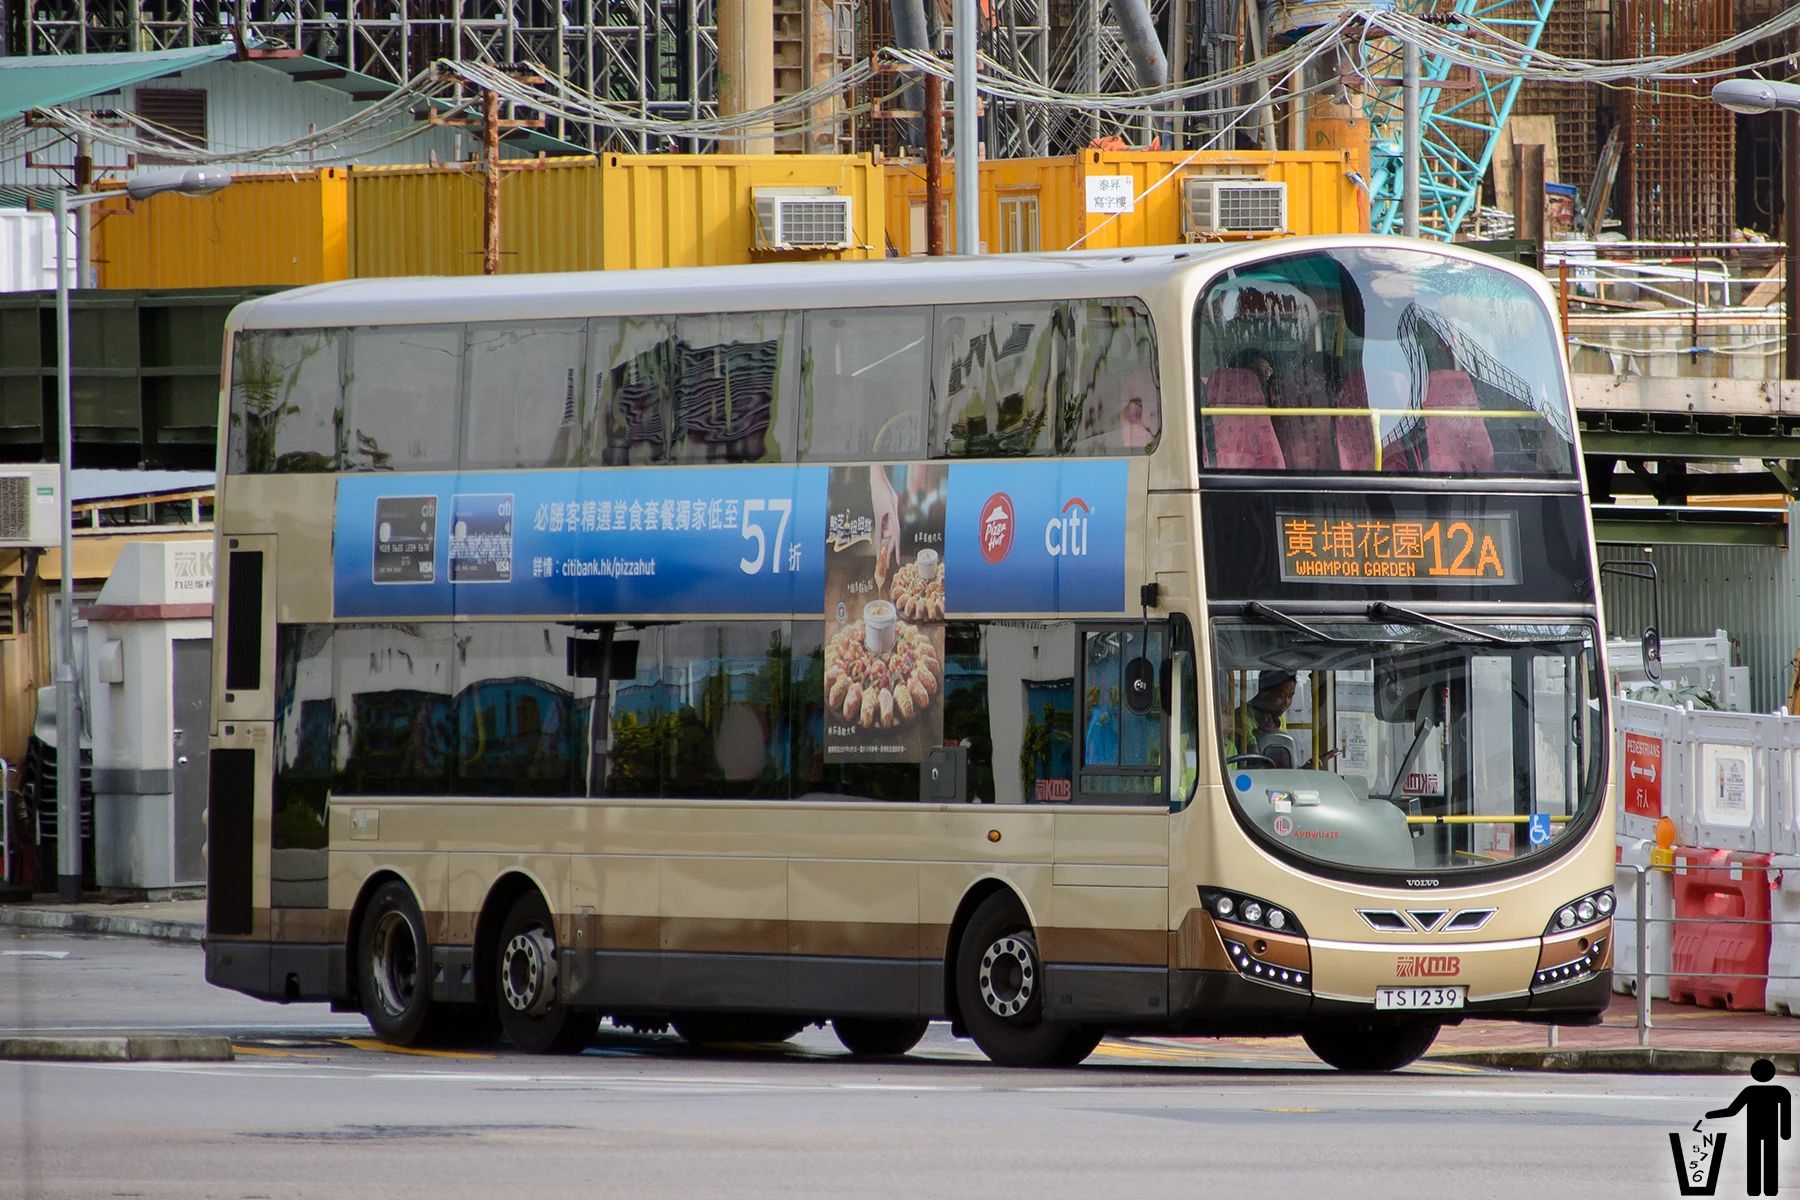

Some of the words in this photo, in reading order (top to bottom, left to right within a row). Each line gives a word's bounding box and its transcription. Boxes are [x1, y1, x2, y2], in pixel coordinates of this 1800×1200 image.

[1094, 196, 1127, 208] 寫字樓
[740, 498, 792, 575] 57
[788, 542, 802, 572] 折
[985, 521, 1007, 542] Pizza
[1045, 507, 1088, 556] citi
[1284, 519, 1424, 559] 黃埔花園
[988, 533, 1006, 552] Hut
[1424, 521, 1504, 576] 12A
[418, 561, 433, 573] VISA
[1296, 560, 1360, 576] WHAMPOA
[1364, 561, 1416, 577] GARDEN
[1626, 739, 1661, 758] PEDESTRIANS
[1045, 779, 1071, 801] KMB
[1635, 788, 1650, 808] 行人
[1406, 879, 1440, 887] VOLVO
[1414, 956, 1460, 977] KMB
[1383, 990, 1457, 1007] TS1239
